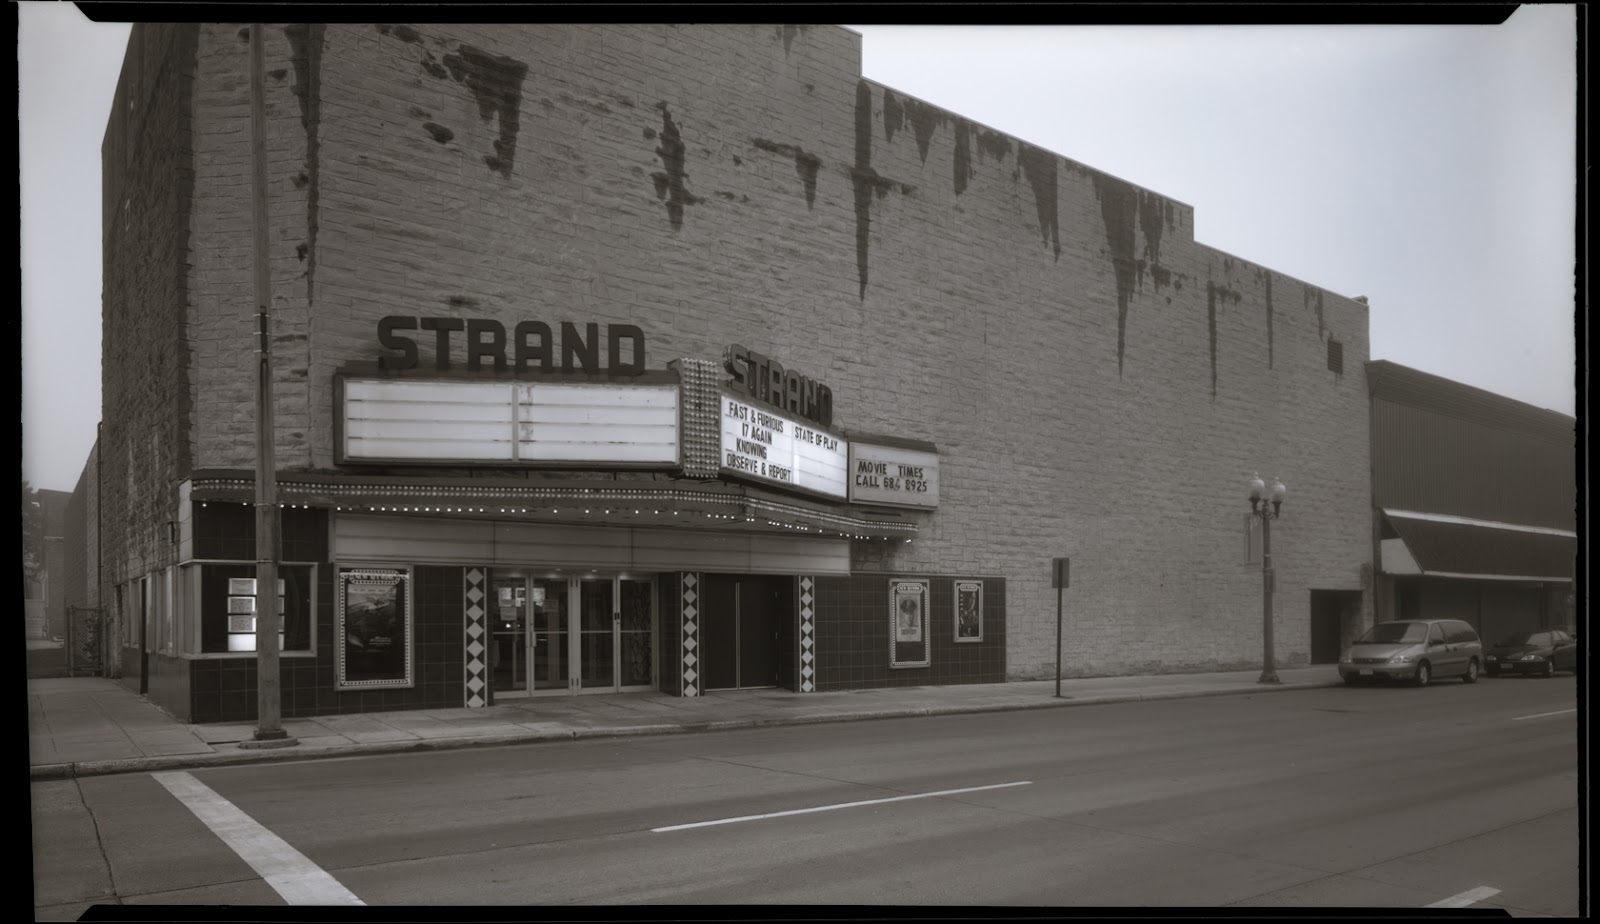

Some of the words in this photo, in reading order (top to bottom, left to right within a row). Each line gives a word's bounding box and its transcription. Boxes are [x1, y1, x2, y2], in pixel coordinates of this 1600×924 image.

[377, 315, 645, 376] STRAND
[723, 343, 833, 428] STRAND
[729, 401, 748, 421] FAST
[750, 409, 756, 424] &
[757, 412, 784, 433] FURIOUS
[742, 422, 749, 437] 17
[751, 426, 773, 445] AGAIN
[794, 426, 813, 444] STATE
[815, 433, 822, 446] OF
[823, 436, 838, 452] PLAY
[736, 437, 767, 459] KNOWING
[727, 453, 758, 473] OBSERVE
[761, 462, 767, 476] &
[768, 464, 791, 482] REPORT
[858, 461, 887, 475] MOVIE
[898, 465, 924, 479] TIMES
[856, 474, 880, 488] CALL
[905, 479, 928, 493] 8925
